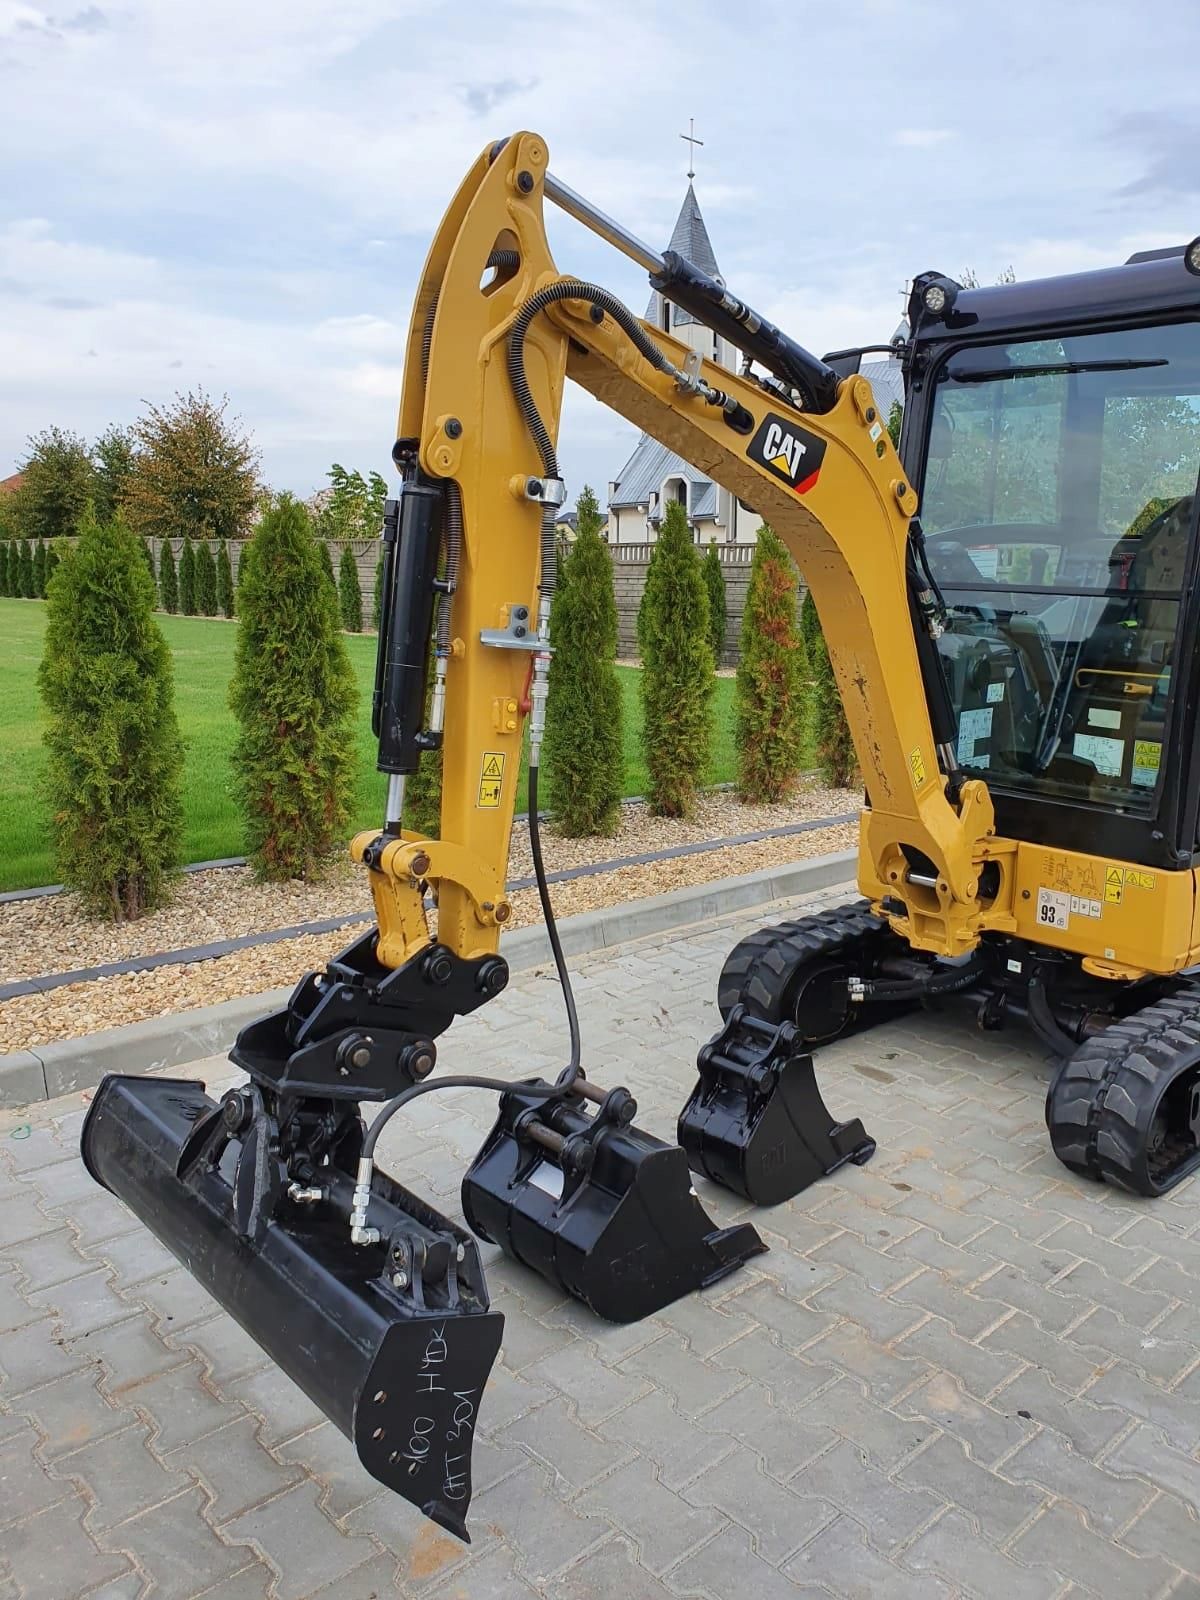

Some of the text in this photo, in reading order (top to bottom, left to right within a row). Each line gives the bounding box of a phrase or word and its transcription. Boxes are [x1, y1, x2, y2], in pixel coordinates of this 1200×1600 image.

[763, 423, 807, 479] CAT
[1041, 904, 1056, 923] 93
[403, 1416, 436, 1464] 100
